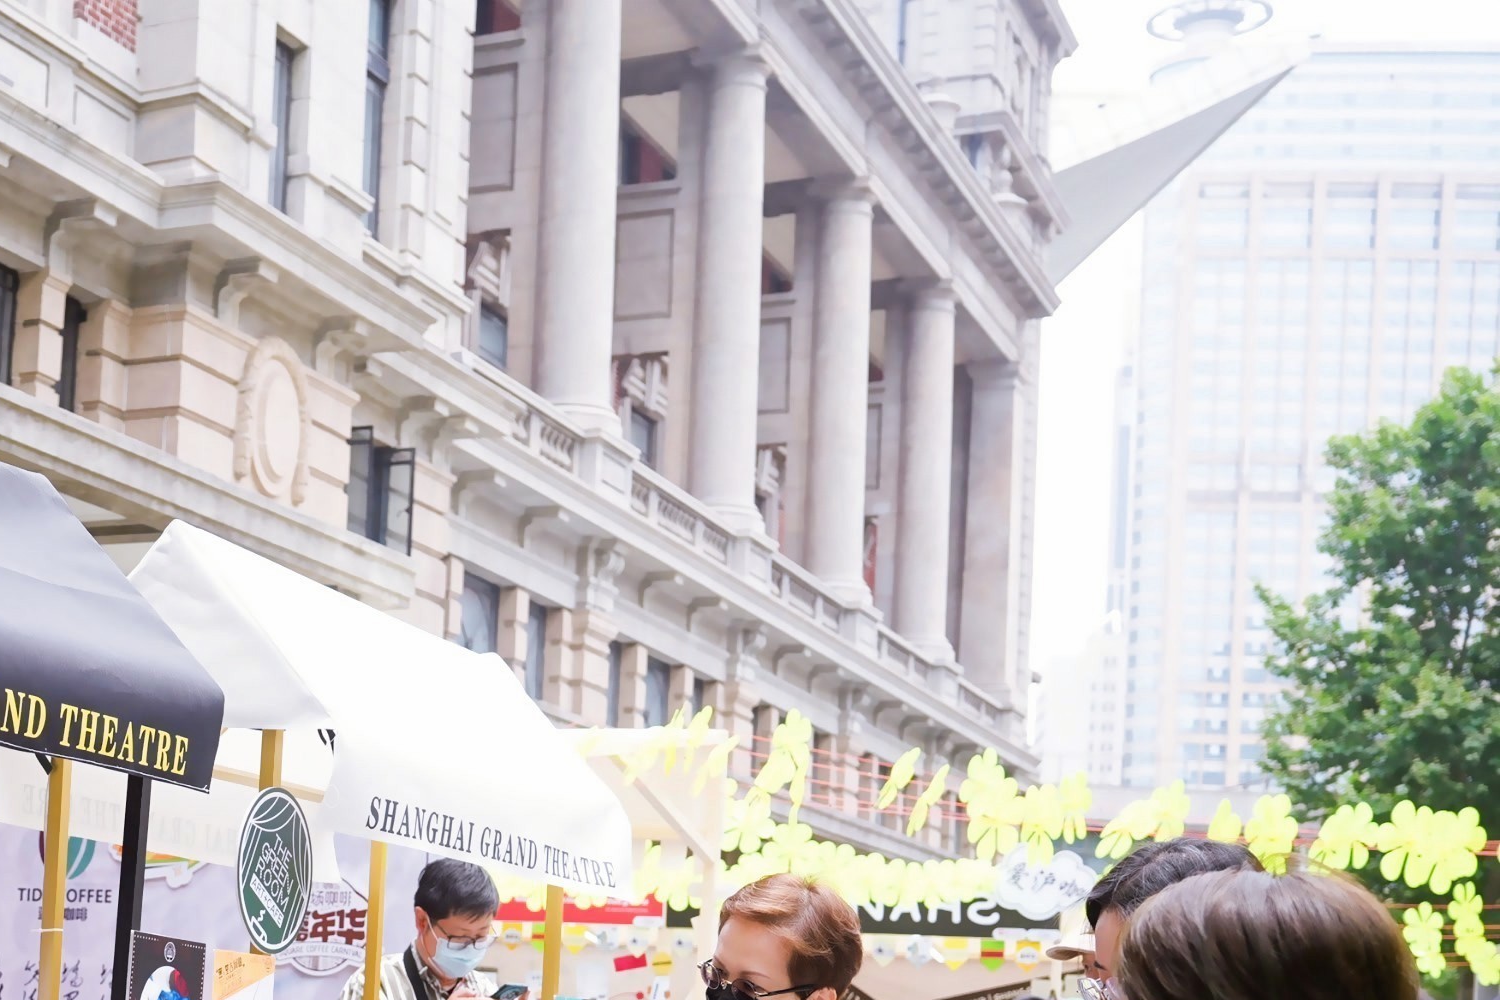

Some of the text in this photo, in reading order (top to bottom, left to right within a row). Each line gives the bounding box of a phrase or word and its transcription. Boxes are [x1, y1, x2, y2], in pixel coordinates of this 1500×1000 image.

[59, 702, 189, 776] THEATRE
[262, 842, 294, 895] GREEN
[273, 833, 292, 869] THE
[365, 796, 616, 888] SHANGHAI GRAND THEATRE
[18, 888, 112, 903] TID OFFEE
[255, 856, 289, 912] ROOM
